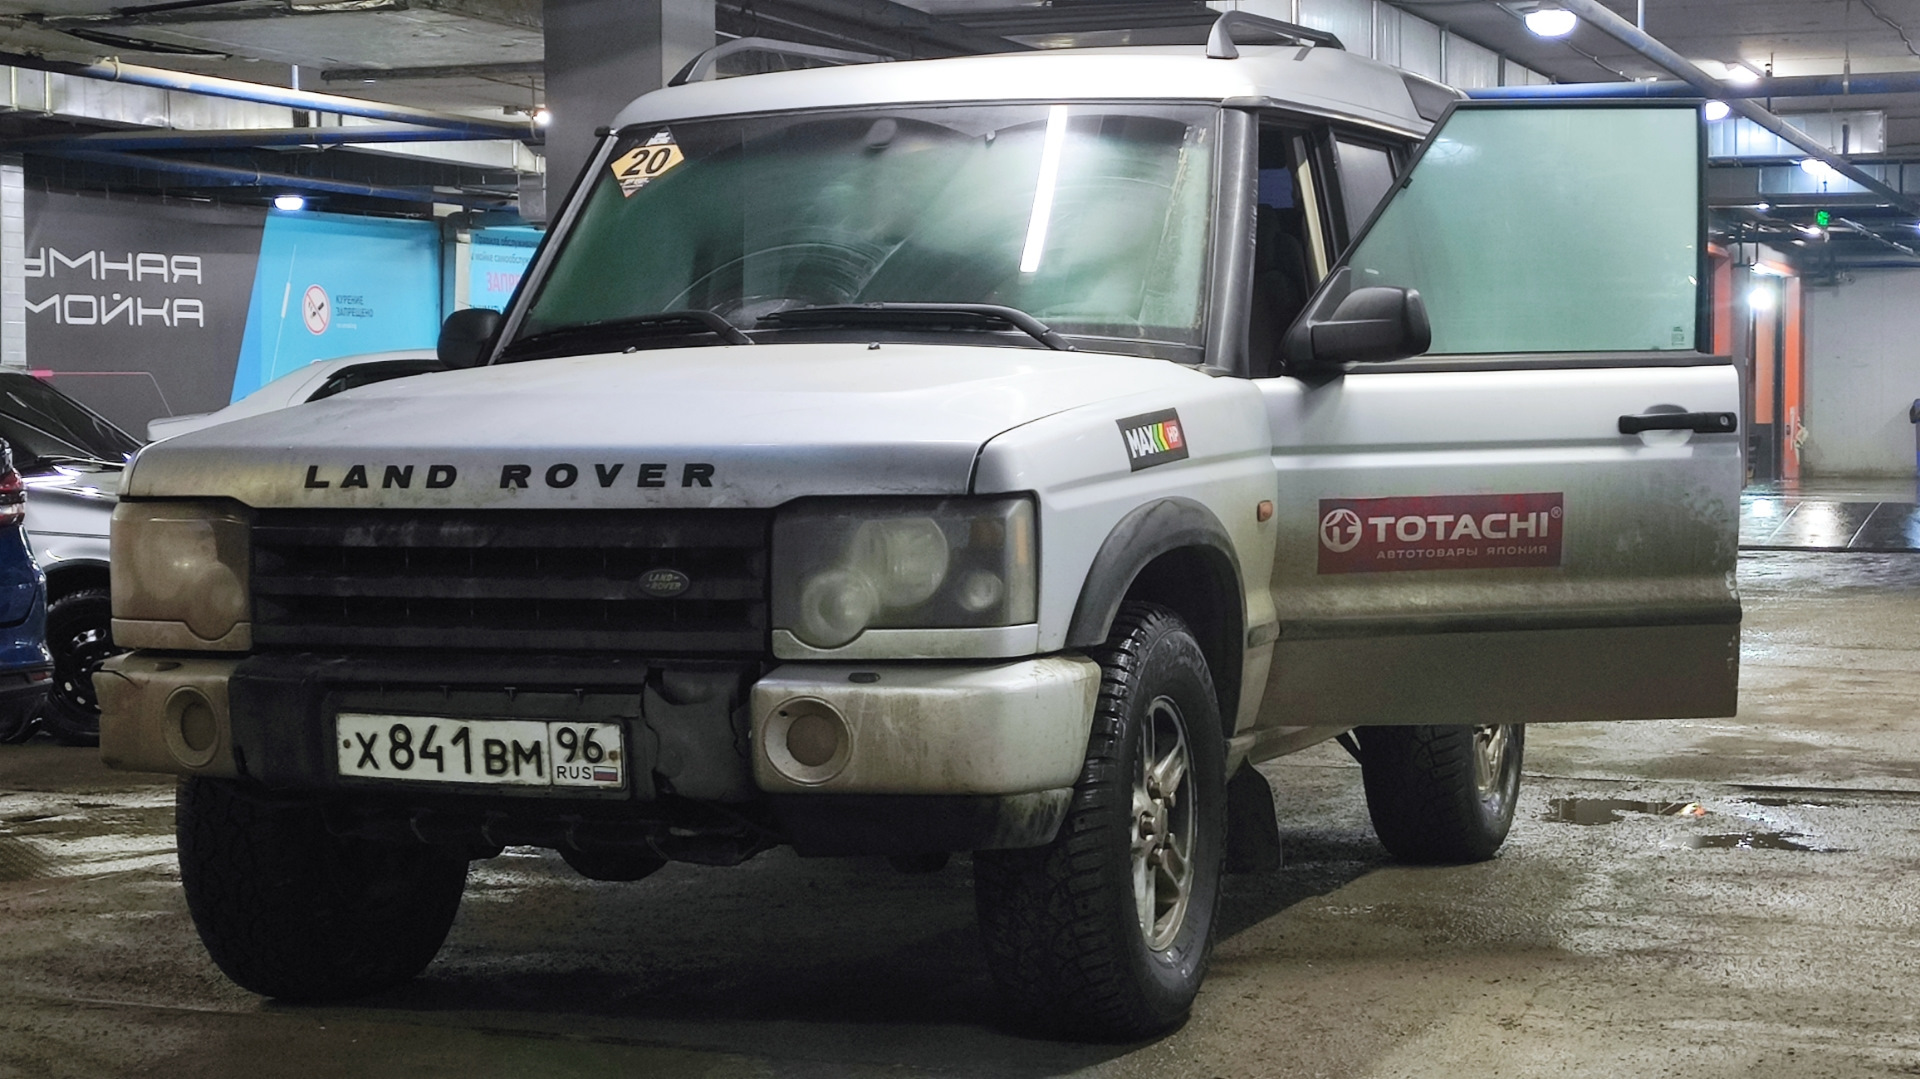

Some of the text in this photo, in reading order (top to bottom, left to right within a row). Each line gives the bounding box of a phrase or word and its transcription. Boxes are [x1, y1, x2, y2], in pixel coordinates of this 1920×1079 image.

[621, 148, 671, 176] 20
[25, 247, 202, 284] УМНАЯ
[25, 293, 204, 328] МОЙКА
[1125, 424, 1159, 458] MAX
[304, 463, 715, 489] LAND ROVER
[1376, 545, 1548, 560] АВТОТОВАРЫ ЯПОНИЯ
[556, 726, 604, 763] 96
[556, 765, 592, 780] RUS
